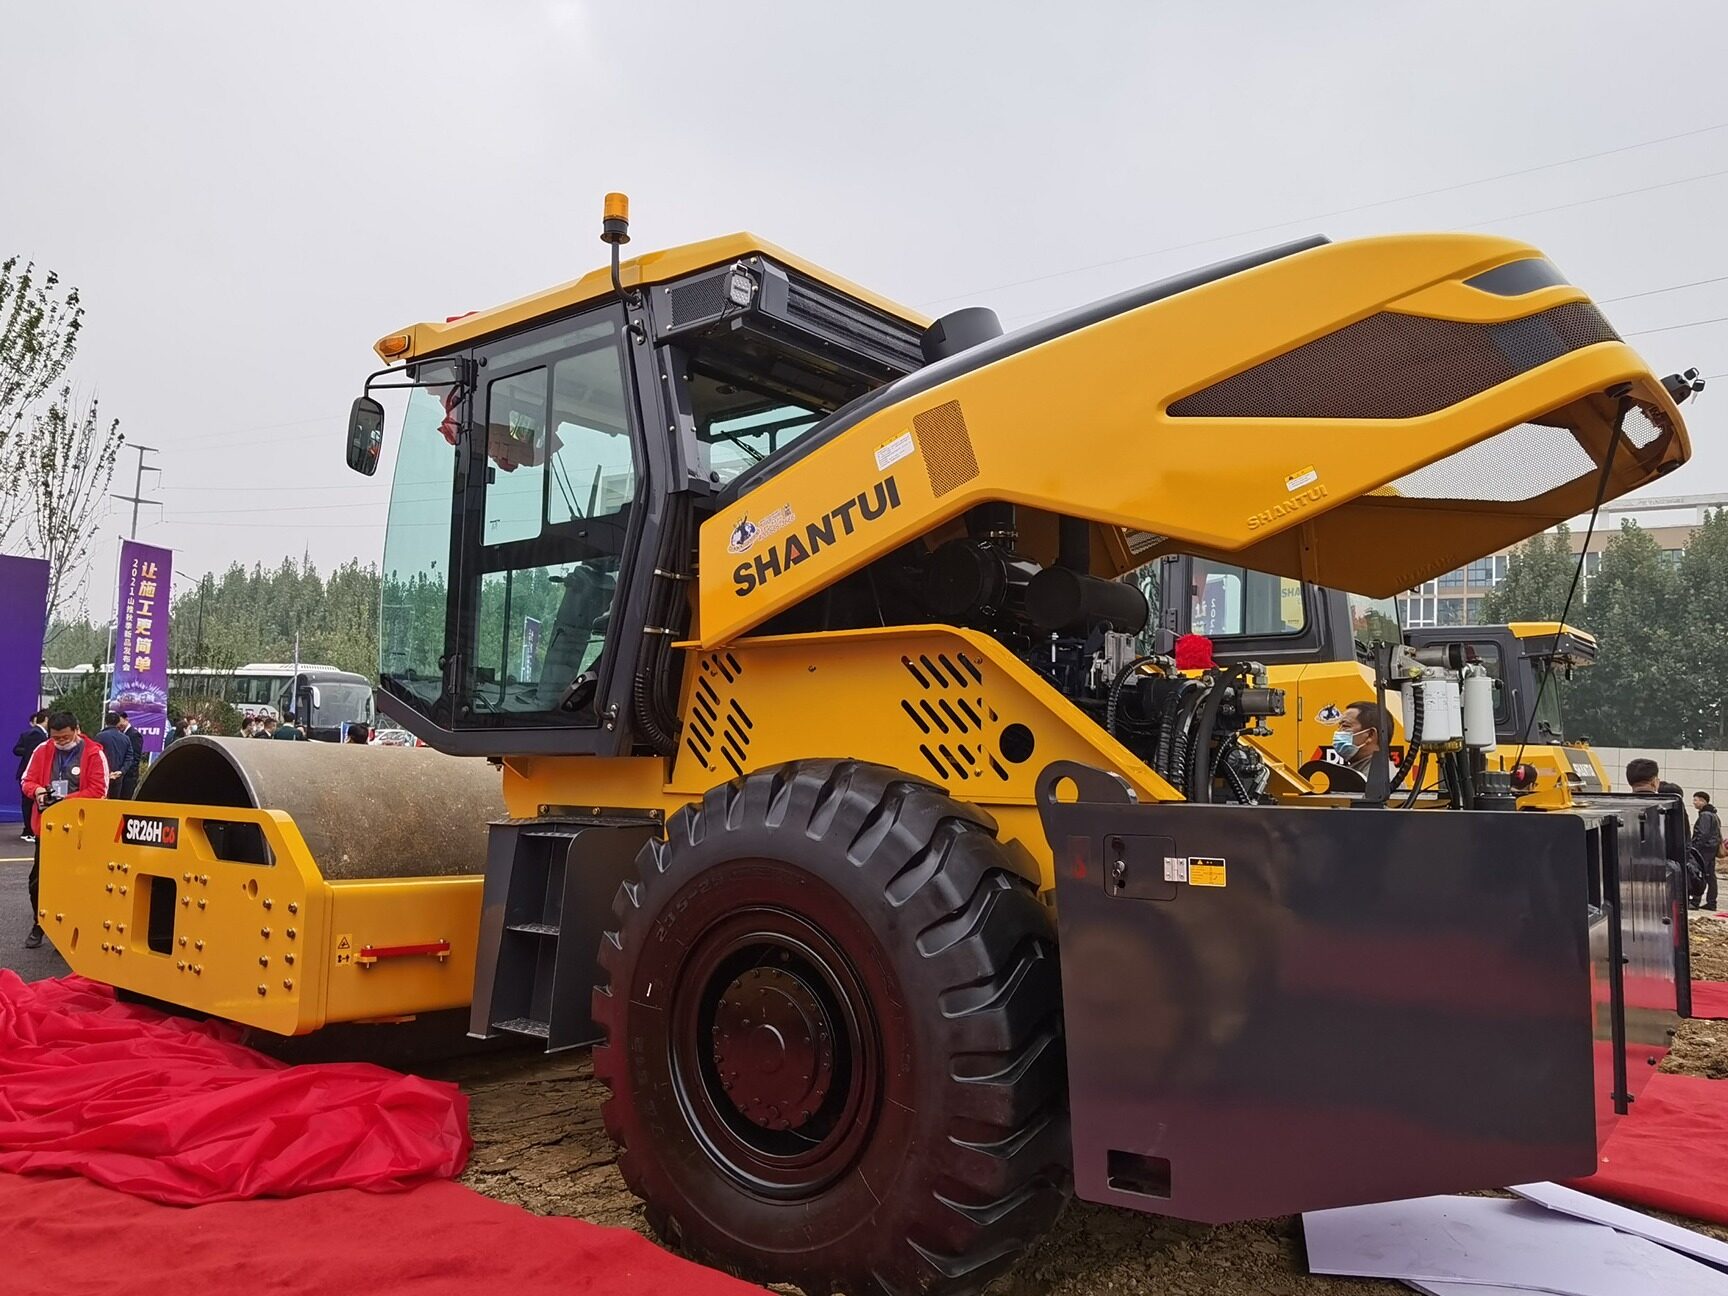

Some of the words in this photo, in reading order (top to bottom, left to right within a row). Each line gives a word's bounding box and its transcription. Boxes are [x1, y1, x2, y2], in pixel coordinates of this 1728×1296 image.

[733, 475, 901, 597] SHANTUI
[1247, 484, 1328, 531] SHANTUI
[134, 561, 158, 673] 让施工更简单
